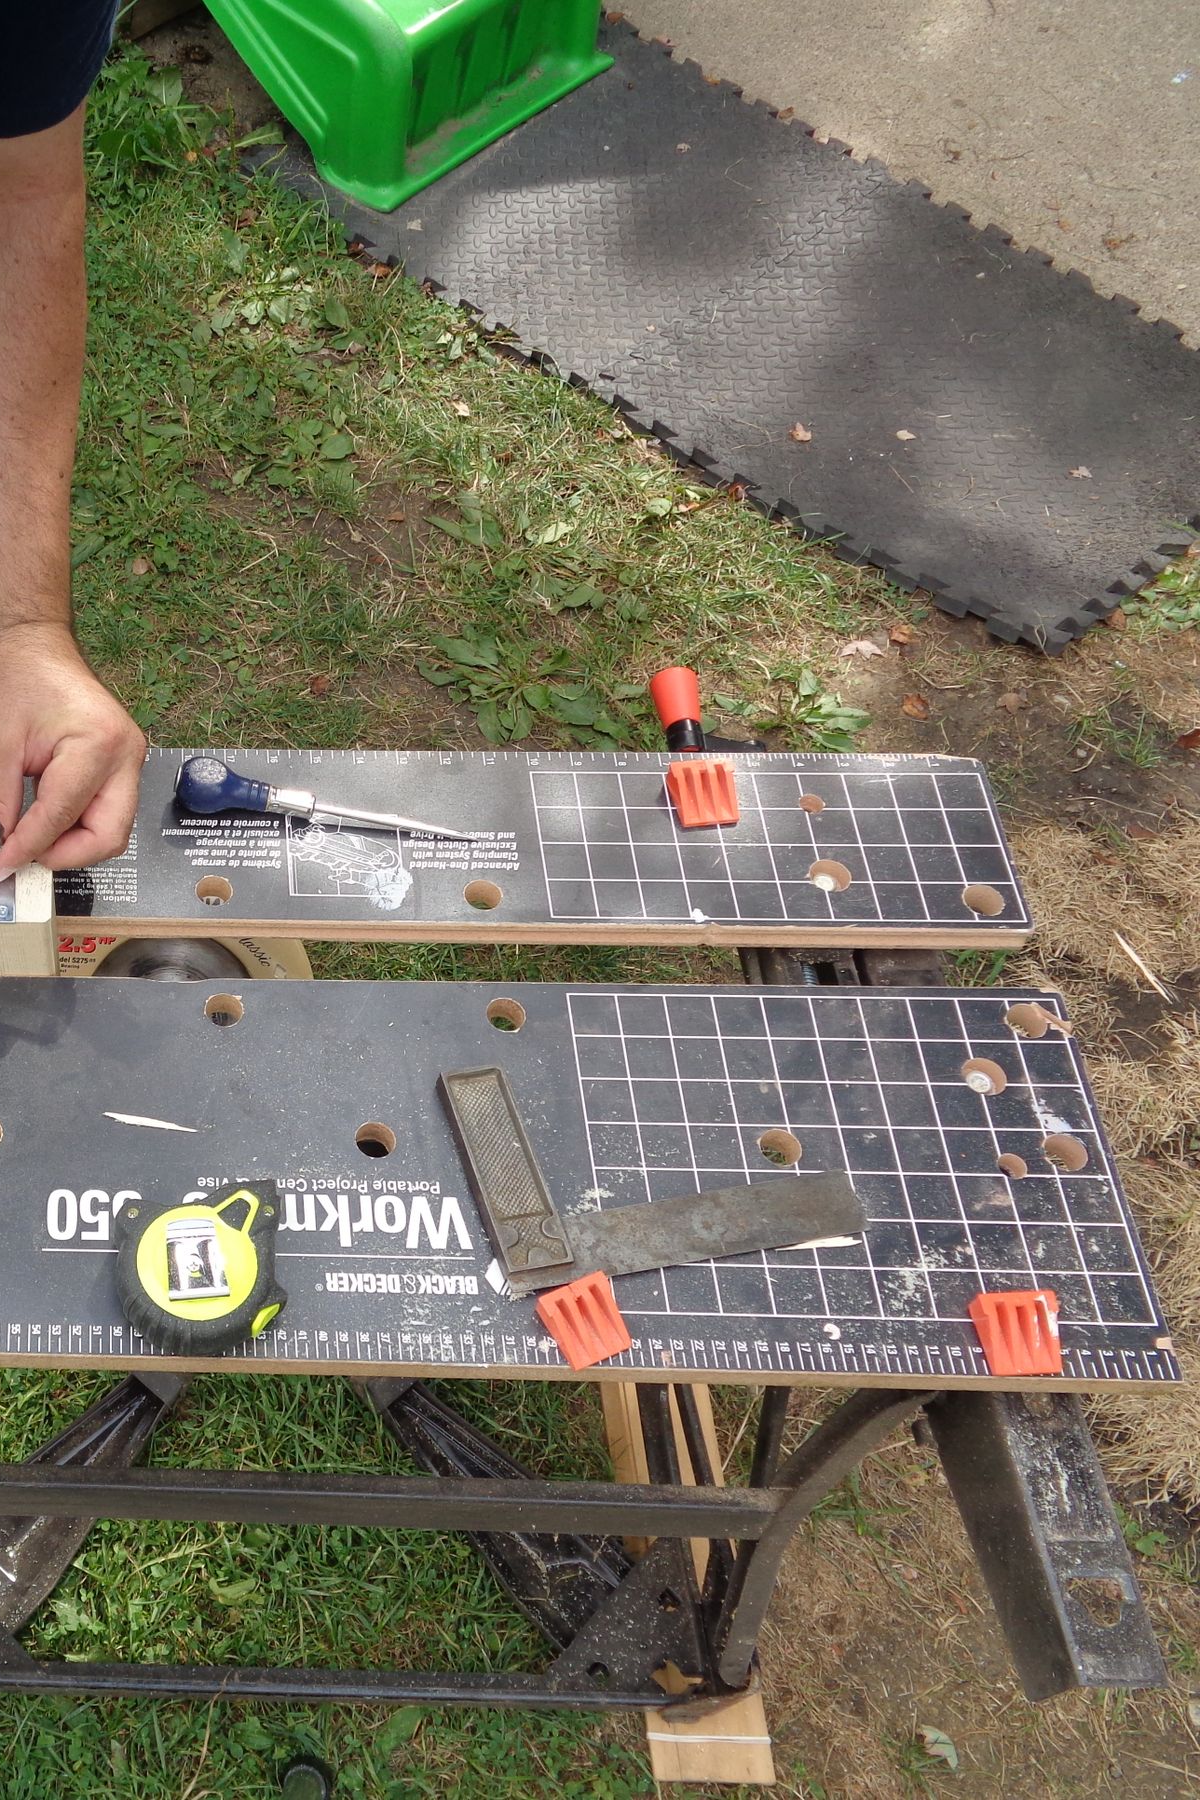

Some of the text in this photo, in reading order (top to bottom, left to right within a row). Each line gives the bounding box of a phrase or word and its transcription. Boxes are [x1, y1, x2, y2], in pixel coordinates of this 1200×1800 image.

[179, 818, 217, 827] douceur.
[233, 819, 270, 827] courroie
[161, 828, 221, 836] entraînement
[243, 829, 279, 837] exclusif
[465, 831, 495, 839] Smoo
[496, 831, 515, 839] and
[196, 837, 246, 847] embrayage
[257, 839, 280, 847] main
[402, 839, 516, 850] Exclusive Clutch Design
[184, 848, 208, 856] seule
[211, 849, 235, 857] d'une
[238, 848, 267, 857] pointe
[412, 850, 518, 859] Clamping System with
[191, 857, 281, 868] Système de serrage
[409, 861, 519, 869] Advanced One-Handed
[57, 935, 116, 953] 2.5 HP
[276, 1177, 307, 1192] Cen
[311, 1174, 367, 1192] Project
[371, 1176, 439, 1194] Portable
[276, 1193, 473, 1249] Workm
[11, 1324, 21, 1334] 55
[32, 1324, 41, 1335] 54
[52, 1325, 62, 1335] 53
[72, 1325, 82, 1336] 52
[93, 1325, 102, 1336] 51
[113, 1326, 123, 1337] 50
[277, 1330, 287, 1340] 42
[298, 1330, 307, 1341] 41
[318, 1331, 328, 1341] 40
[339, 1331, 349, 1342] 39
[360, 1332, 370, 1342] 38
[380, 1332, 390, 1343] 37
[505, 1335, 515, 1346] 31
[526, 1336, 536, 1346] 30
[631, 1338, 641, 1349] 25
[652, 1339, 663, 1349] 24
[673, 1339, 684, 1350] 23
[694, 1340, 705, 1350] 22
[716, 1340, 726, 1351] 21
[737, 1341, 747, 1351] 20
[758, 1341, 769, 1352] 19
[779, 1342, 790, 1352] 18
[801, 1342, 811, 1353] 17
[822, 1343, 833, 1354] 16
[843, 1343, 854, 1354] 15
[865, 1344, 876, 1355] 14
[886, 1344, 897, 1355] 13
[908, 1345, 919, 1356] 12
[929, 1345, 940, 1356] 11
[951, 1346, 962, 1357] 10
